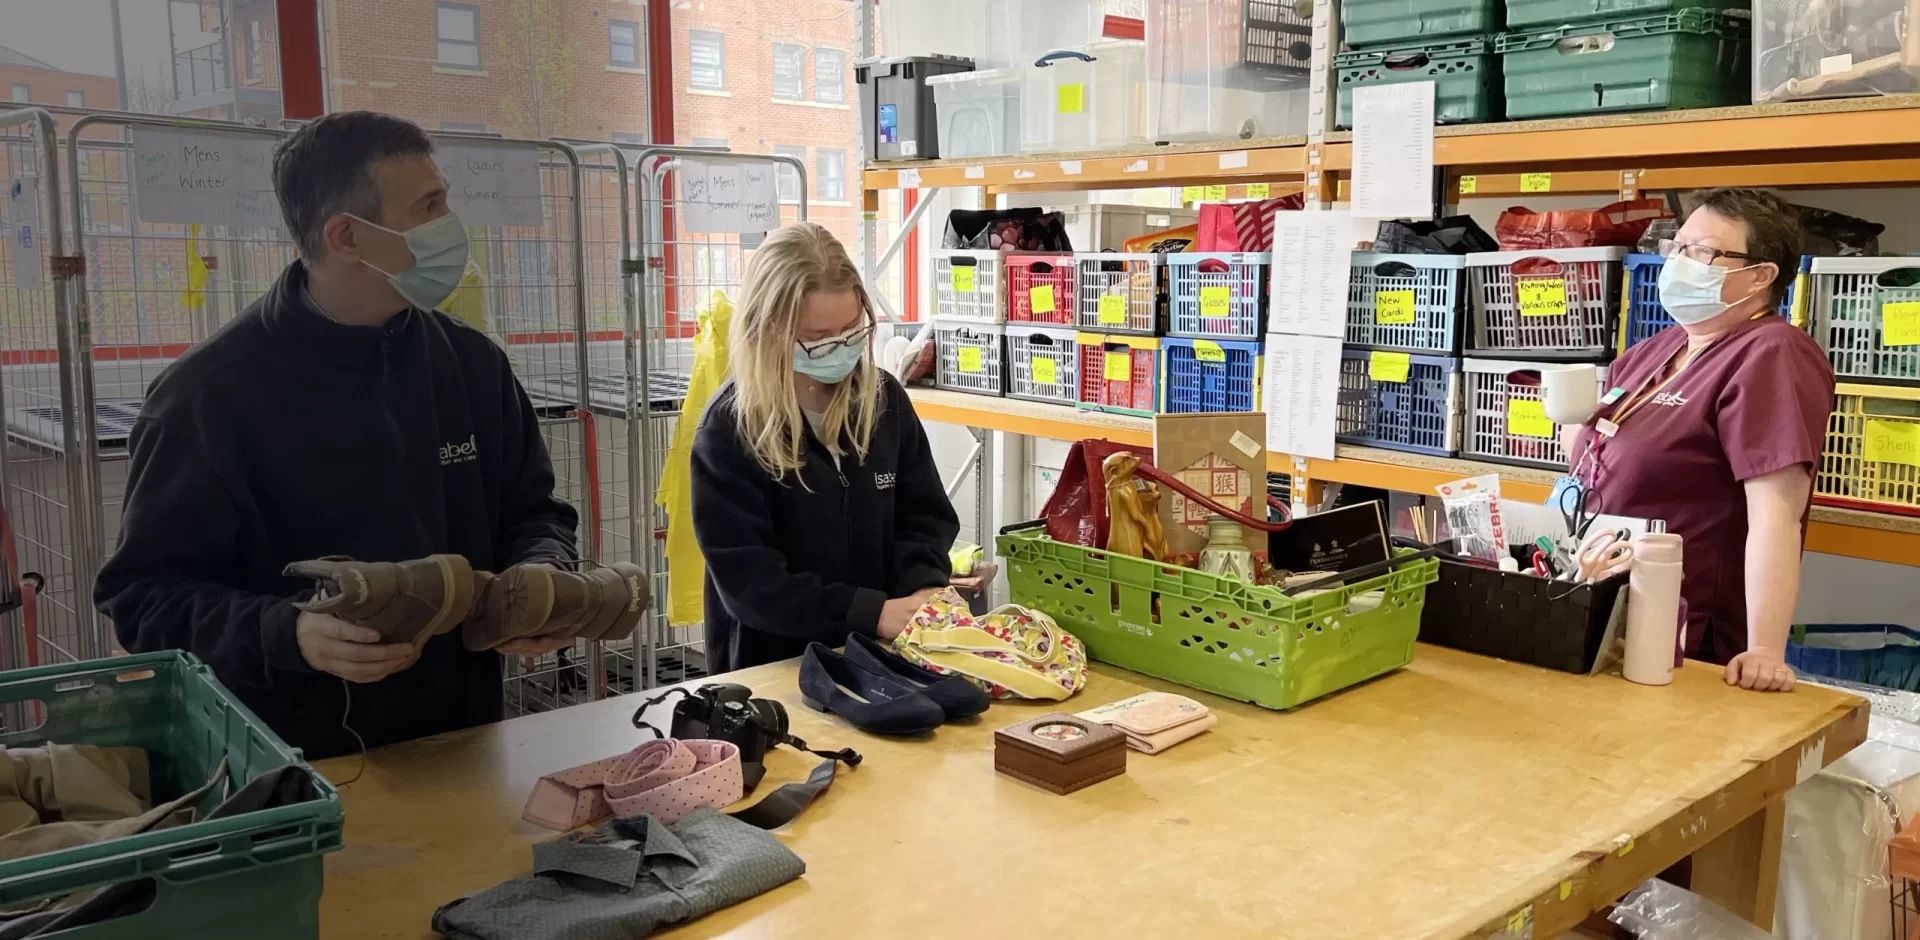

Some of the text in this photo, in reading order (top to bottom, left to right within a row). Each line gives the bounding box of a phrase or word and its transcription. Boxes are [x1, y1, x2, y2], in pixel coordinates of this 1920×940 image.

[183, 145, 221, 169] Mens
[465, 156, 504, 175] Ladies
[179, 168, 233, 190] Winter
[713, 176, 736, 191] Mens
[1202, 295, 1226, 308] Glasses
[1379, 295, 1401, 305] New
[1381, 306, 1405, 318] Cards
[439, 433, 478, 460] abel
[1874, 435, 1917, 453] Shells
[1215, 474, 1235, 494] 猴
